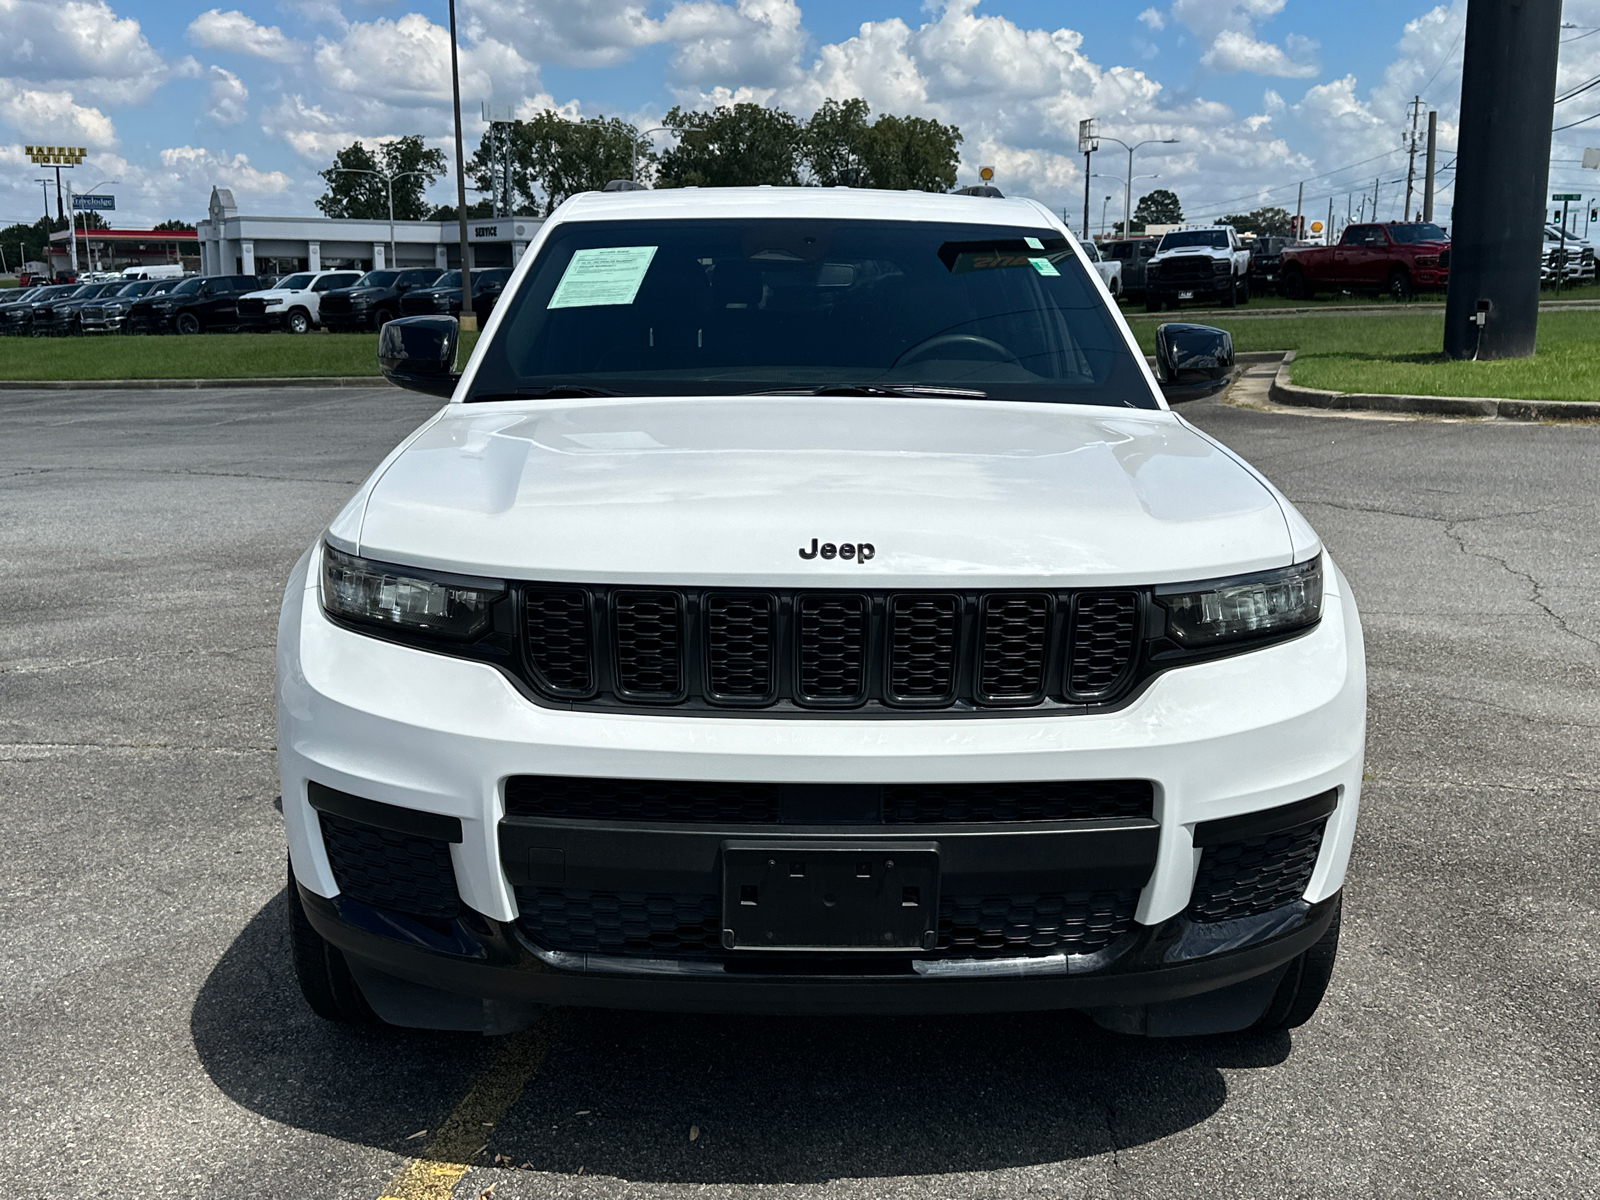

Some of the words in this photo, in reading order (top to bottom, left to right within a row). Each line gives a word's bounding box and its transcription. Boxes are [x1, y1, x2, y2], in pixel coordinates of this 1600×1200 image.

[26, 146, 86, 156] WAFFLE
[32, 156, 81, 164] HOUSE
[73, 197, 113, 206] ravelodge
[475, 226, 497, 237] SERVICE
[798, 538, 876, 564] Jeep
